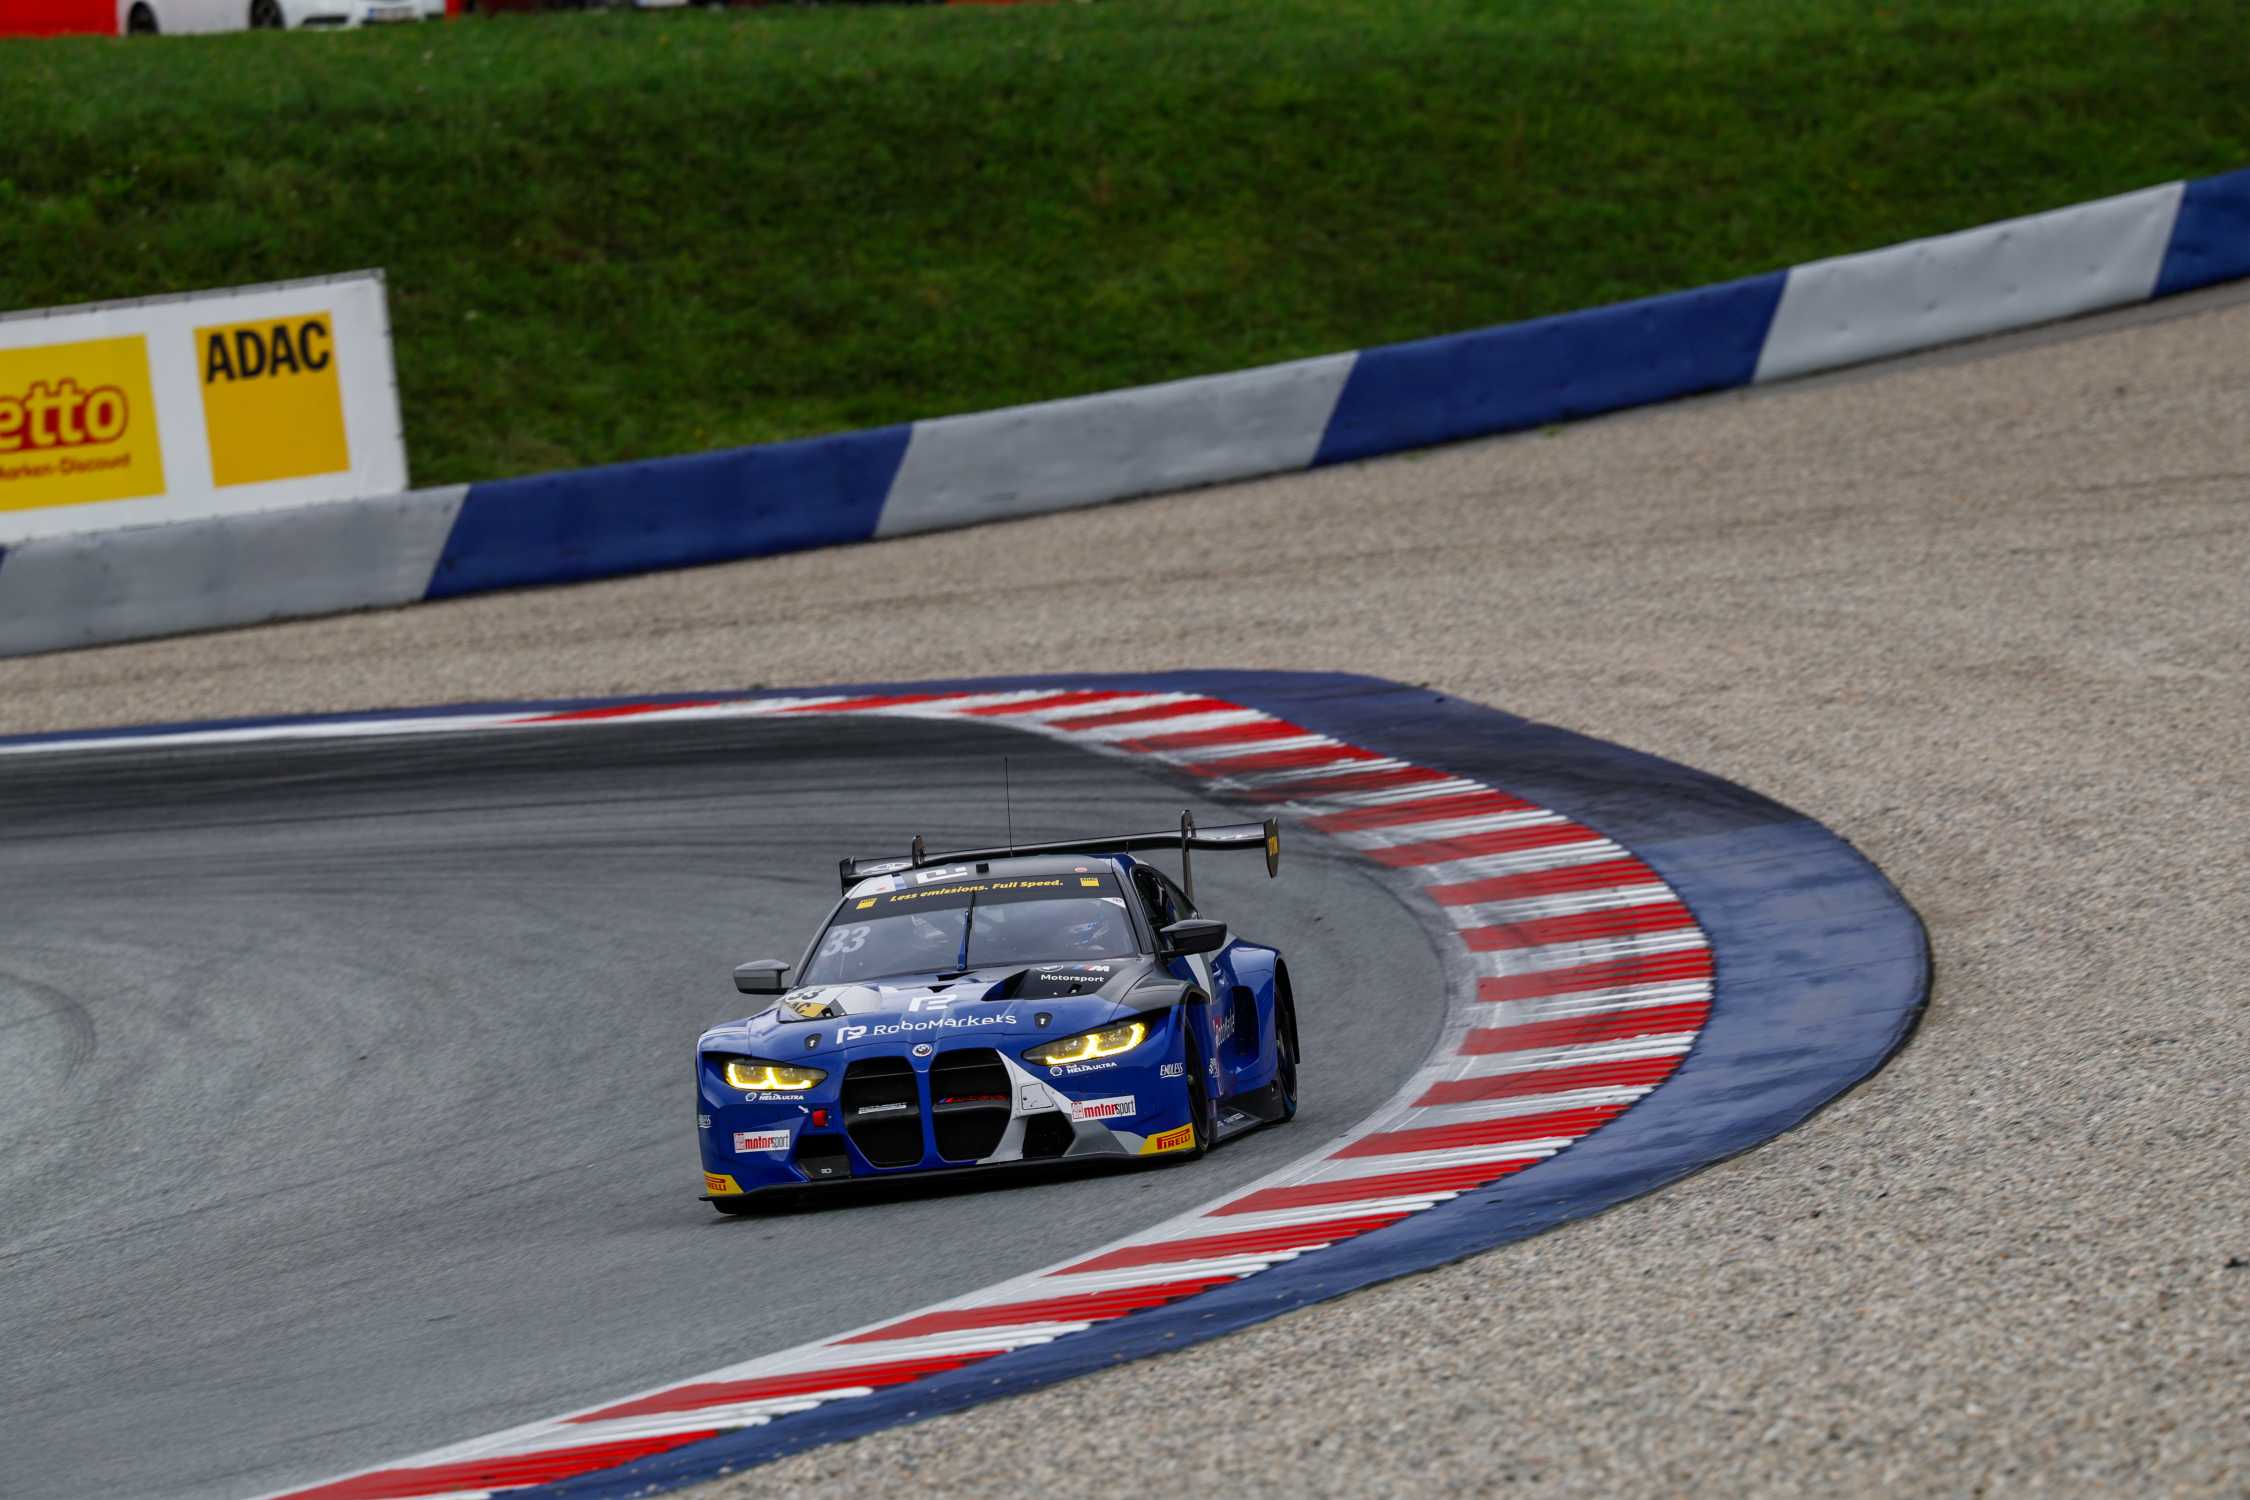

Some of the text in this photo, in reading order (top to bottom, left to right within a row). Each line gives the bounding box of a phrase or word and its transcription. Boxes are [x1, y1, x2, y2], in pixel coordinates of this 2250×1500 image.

[206, 320, 331, 384] ADAC
[0, 454, 131, 480] arken-Discount
[890, 879, 1064, 903] Less emissions. Full Speed.
[820, 926, 871, 957] 33
[1040, 974, 1105, 983] Motorsport
[873, 1014, 1017, 1036] RoboMarkets
[1084, 1100, 1135, 1118] motorsport
[1156, 1127, 1191, 1150] PIRELLI
